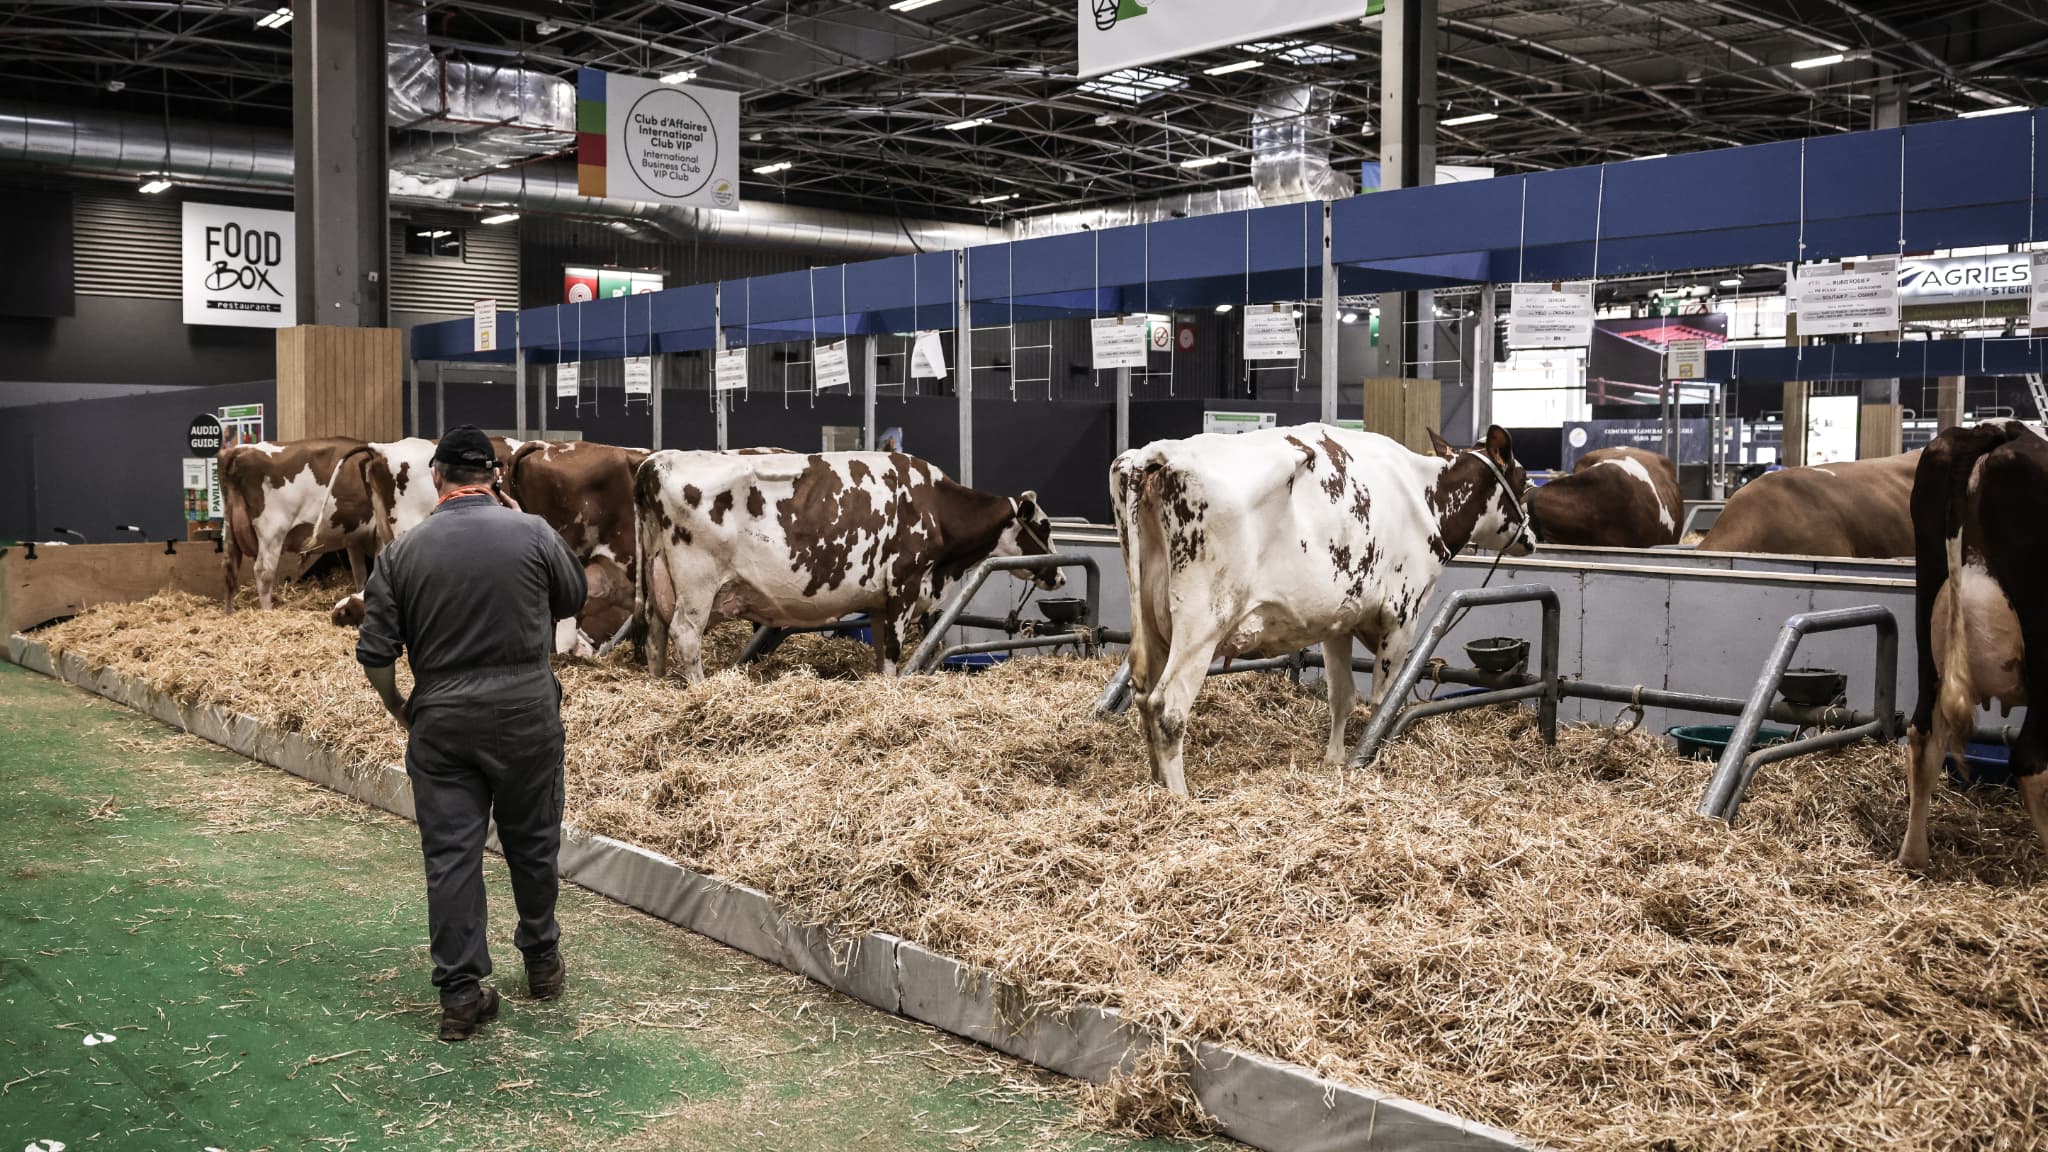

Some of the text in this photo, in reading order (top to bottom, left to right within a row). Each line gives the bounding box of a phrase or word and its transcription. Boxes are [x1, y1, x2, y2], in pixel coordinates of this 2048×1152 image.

[634, 113, 708, 132] Club d'Affaires
[639, 125, 703, 142] International
[651, 138, 693, 151] Club VIP
[643, 149, 699, 164] International
[642, 159, 701, 173] Business Club
[653, 169, 689, 181] VIP Club
[206, 222, 281, 266] FOOD
[217, 302, 271, 312] restaurant
[191, 426, 219, 435] AUDIO
[191, 438, 219, 448] GUIDE
[211, 469, 220, 512] PAVILLON
